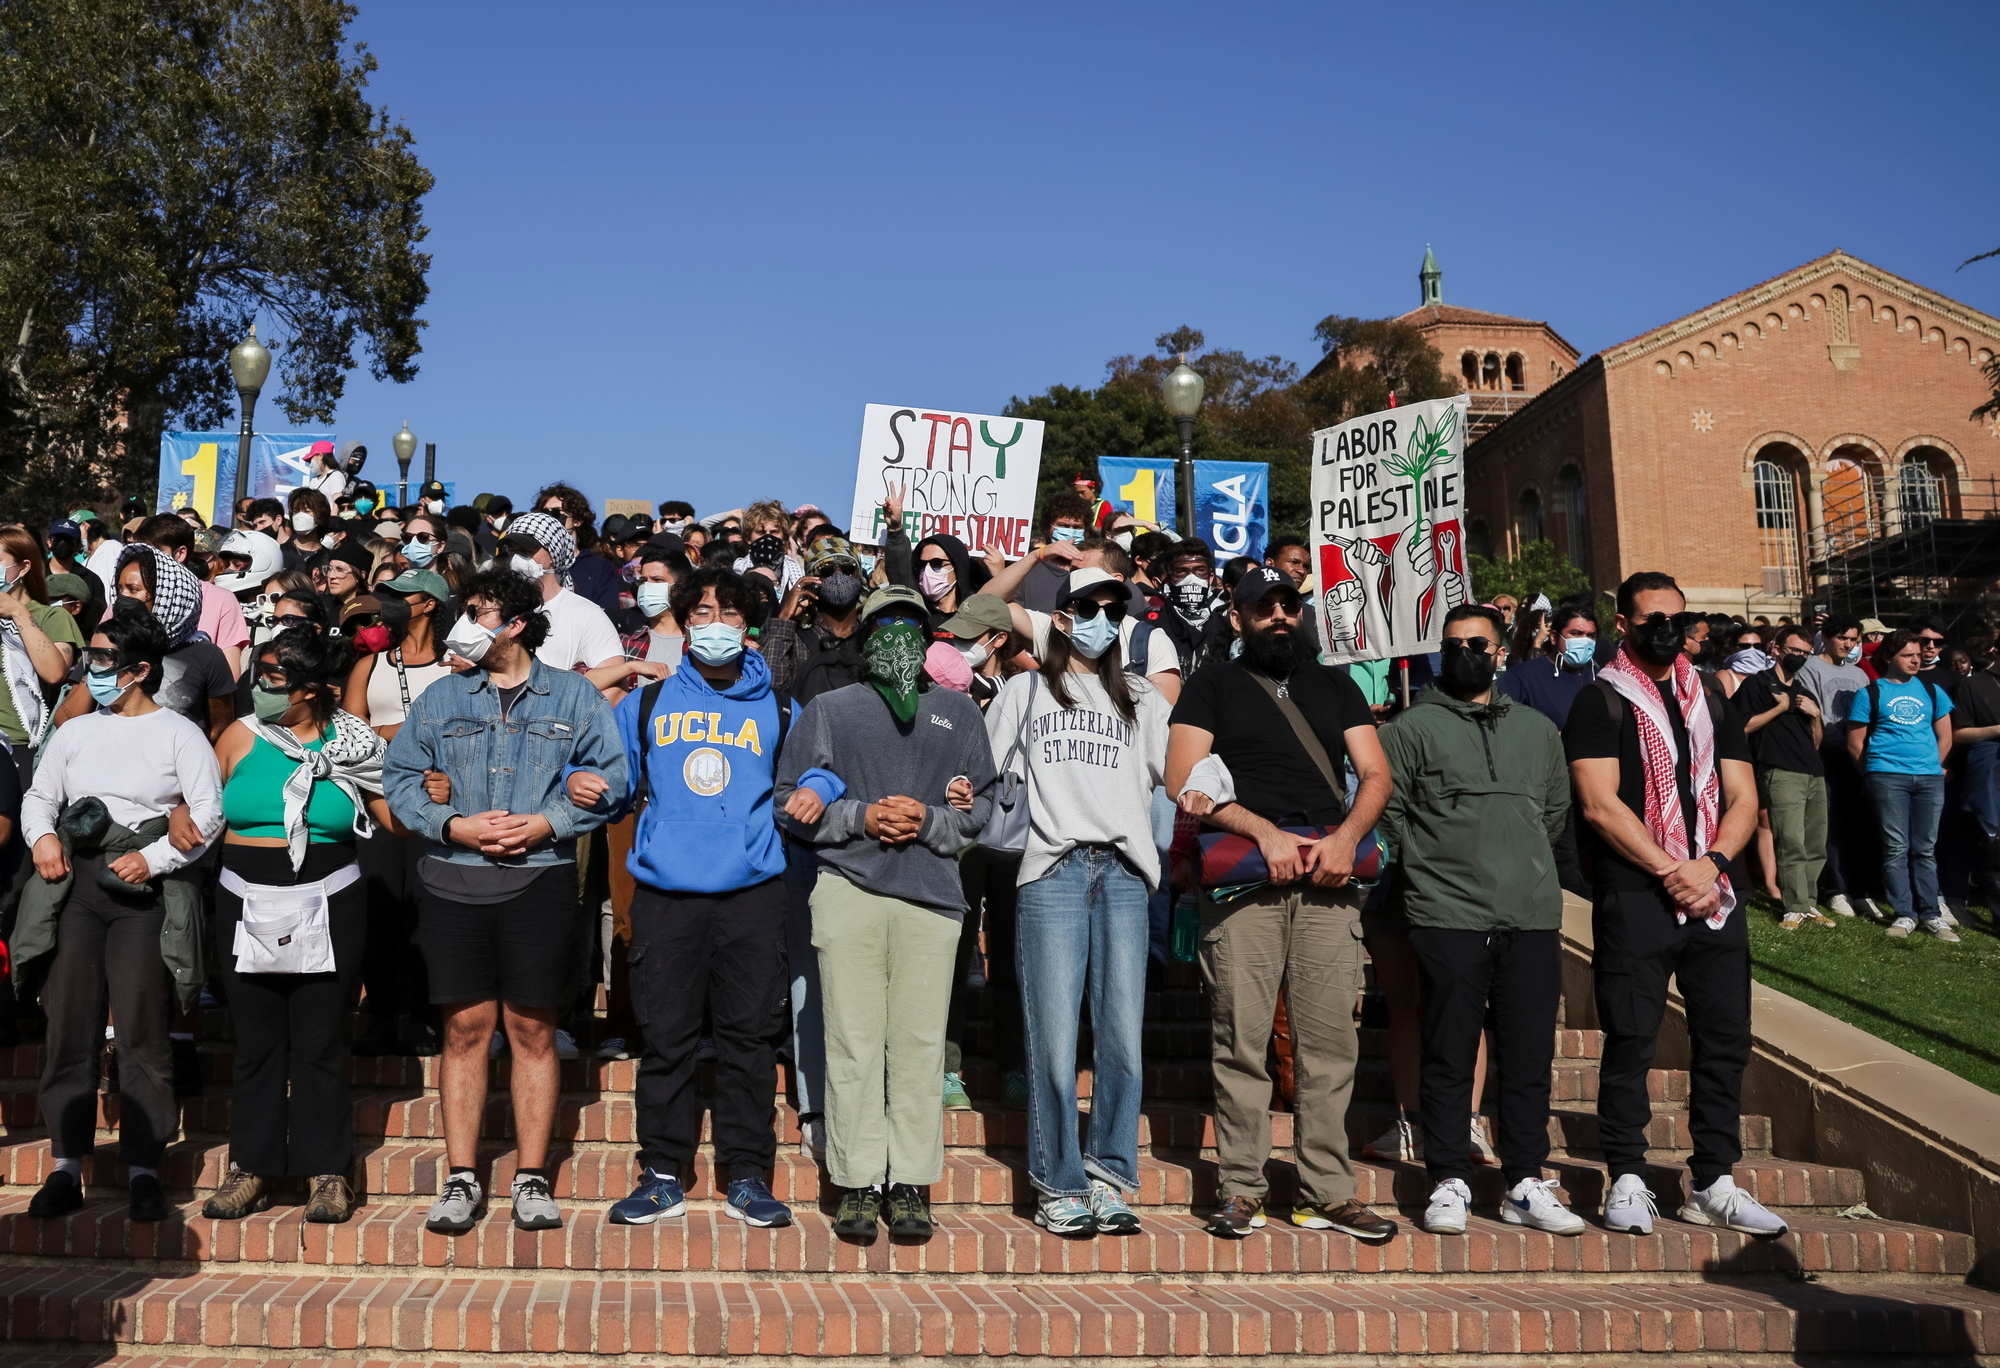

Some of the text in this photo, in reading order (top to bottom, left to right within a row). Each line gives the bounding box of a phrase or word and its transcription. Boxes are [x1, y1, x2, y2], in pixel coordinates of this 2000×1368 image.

[882, 409, 1024, 480] STAY
[1321, 419, 1398, 466] LABOR
[874, 465, 998, 516] STRONG
[1340, 462, 1378, 493] FOR
[853, 508, 1029, 558] #FEEPALESTINE
[1260, 568, 1281, 582] LA
[654, 710, 762, 757] UCLA
[930, 714, 953, 731] Ucla
[1032, 708, 1132, 748] SWITZERLAND
